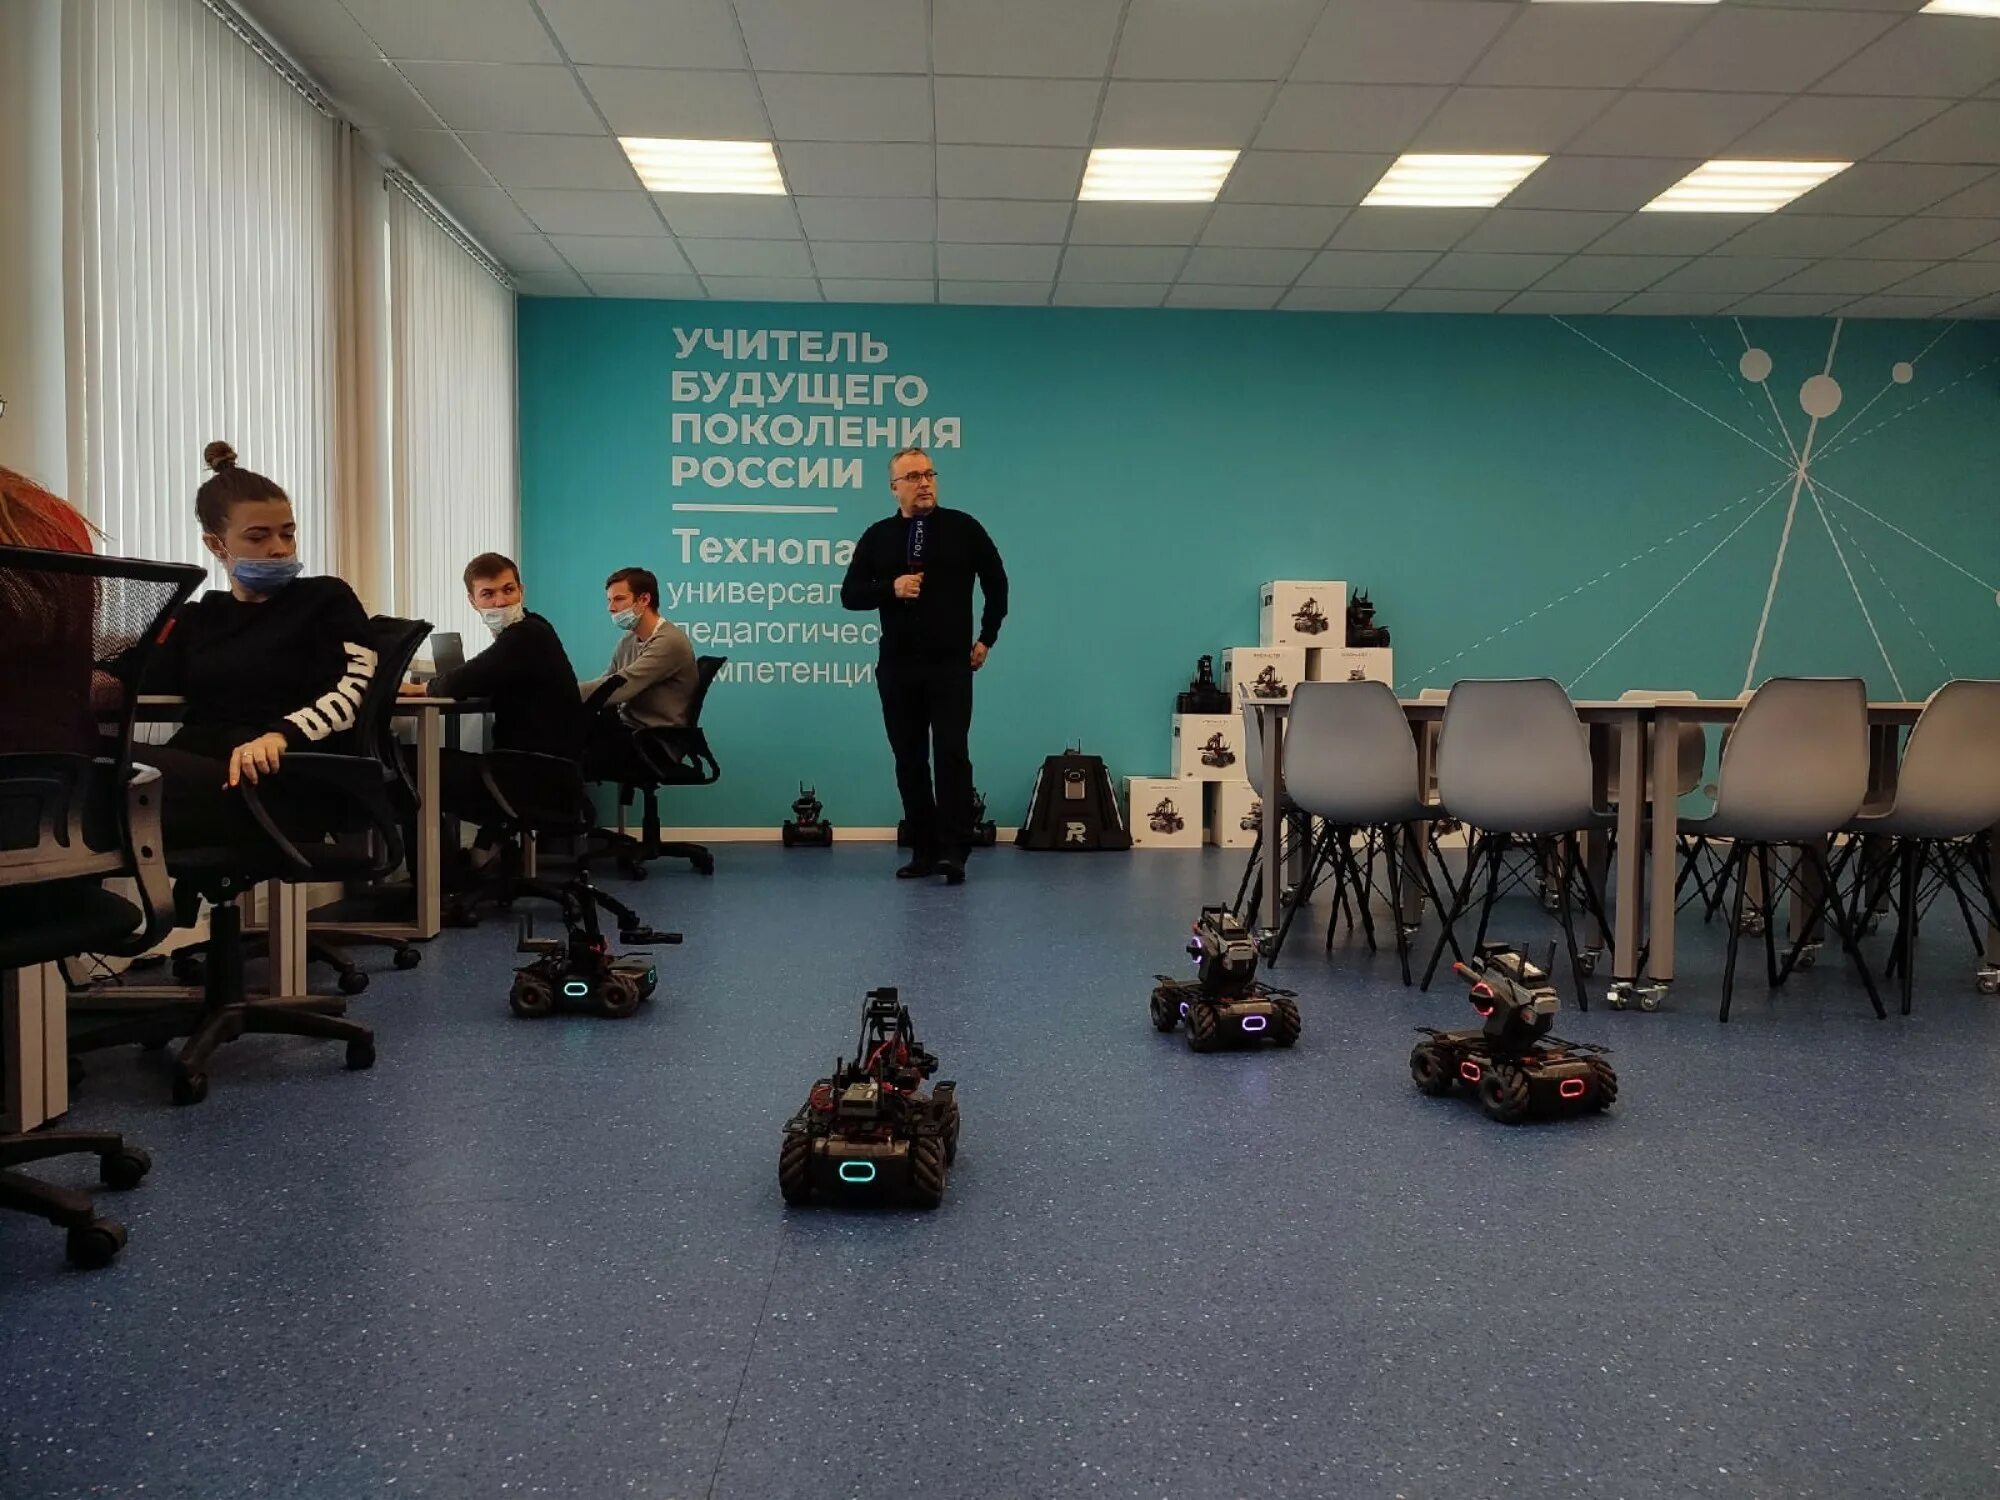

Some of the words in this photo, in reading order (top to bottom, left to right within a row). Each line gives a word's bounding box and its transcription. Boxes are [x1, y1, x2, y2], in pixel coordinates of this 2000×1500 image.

[672, 327, 888, 363] УЧИТЕЛЬ
[671, 370, 929, 410] БУДУЩЕГО
[671, 413, 962, 449] ПОКОЛЕНИЯ
[671, 455, 863, 489] РОССИИ
[672, 528, 856, 566] Технопа
[674, 621, 881, 649] педагогичес
[712, 660, 876, 688] мпетенци
